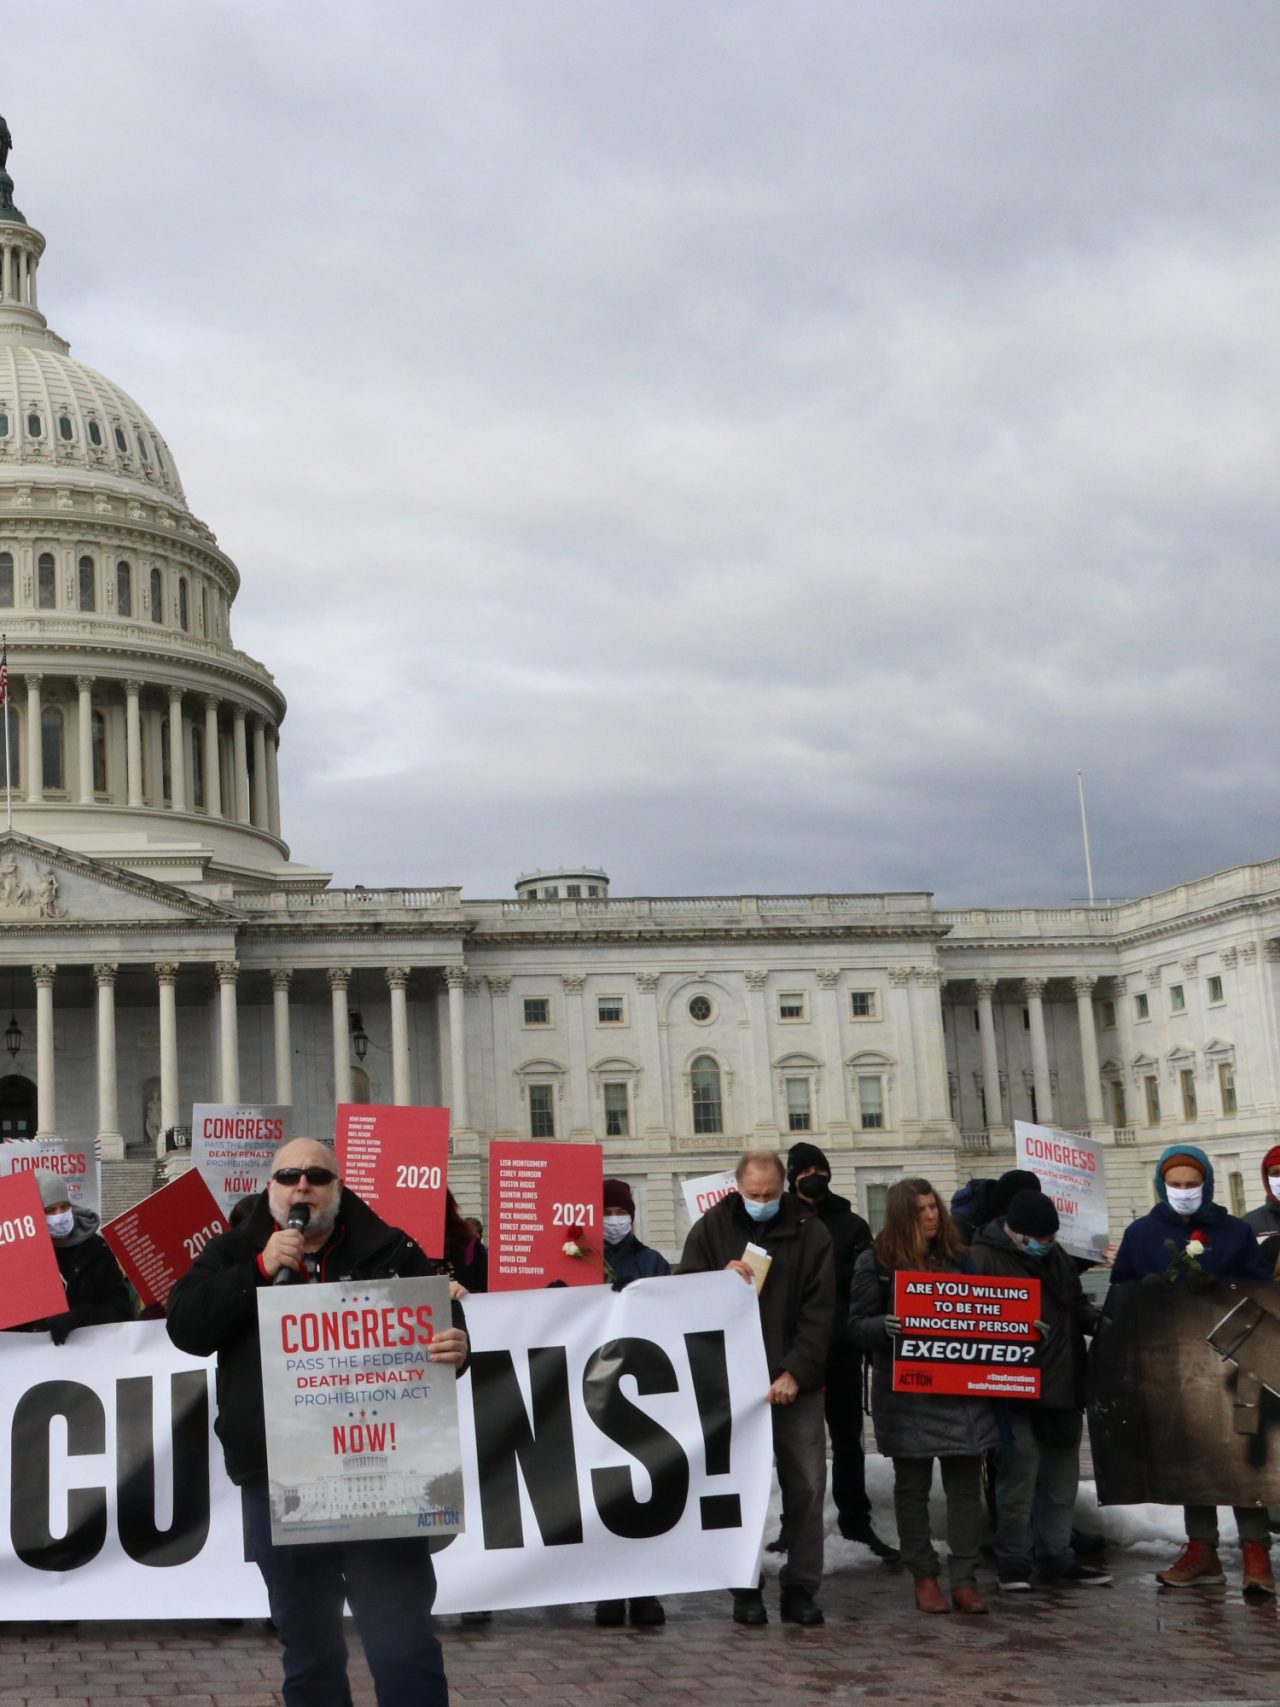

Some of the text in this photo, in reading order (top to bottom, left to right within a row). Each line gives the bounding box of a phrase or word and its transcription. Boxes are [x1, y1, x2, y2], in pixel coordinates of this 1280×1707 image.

[203, 1118, 285, 1141] CONGRESS
[204, 1141, 225, 1149] PASS
[227, 1141, 242, 1149] THE
[207, 1159, 260, 1167] PROHIBITION
[1025, 1137, 1097, 1172] CONGRESS
[11, 1154, 86, 1175] CONGRESS
[500, 1159, 547, 1168] LISA MONTGOMERY
[395, 1165, 441, 1189] 2020
[500, 1170, 541, 1179] COREY JOHNSON
[224, 1177, 258, 1193] NOW!
[522, 1191, 538, 1199] JONES
[500, 1212, 512, 1220] RICK
[552, 1203, 595, 1227] 2021
[500, 1223, 544, 1232] ERNEST JOHNSON
[517, 1234, 533, 1242] SMITH
[499, 1255, 527, 1264] DAVID COX
[906, 1282, 1028, 1300] ARE YOU WILLING
[934, 1301, 1001, 1315] TO BE THE
[280, 1305, 434, 1354] CONGRESS
[905, 1317, 1029, 1334] INNOCENT PERSON
[901, 1340, 1035, 1363] EXECUTED?
[286, 1352, 432, 1371] PASS THE FEDERAL
[297, 1369, 425, 1389] DEATH PENALTY
[294, 1386, 430, 1407] PROHIBITION ACT
[332, 1422, 397, 1455] NOW!
